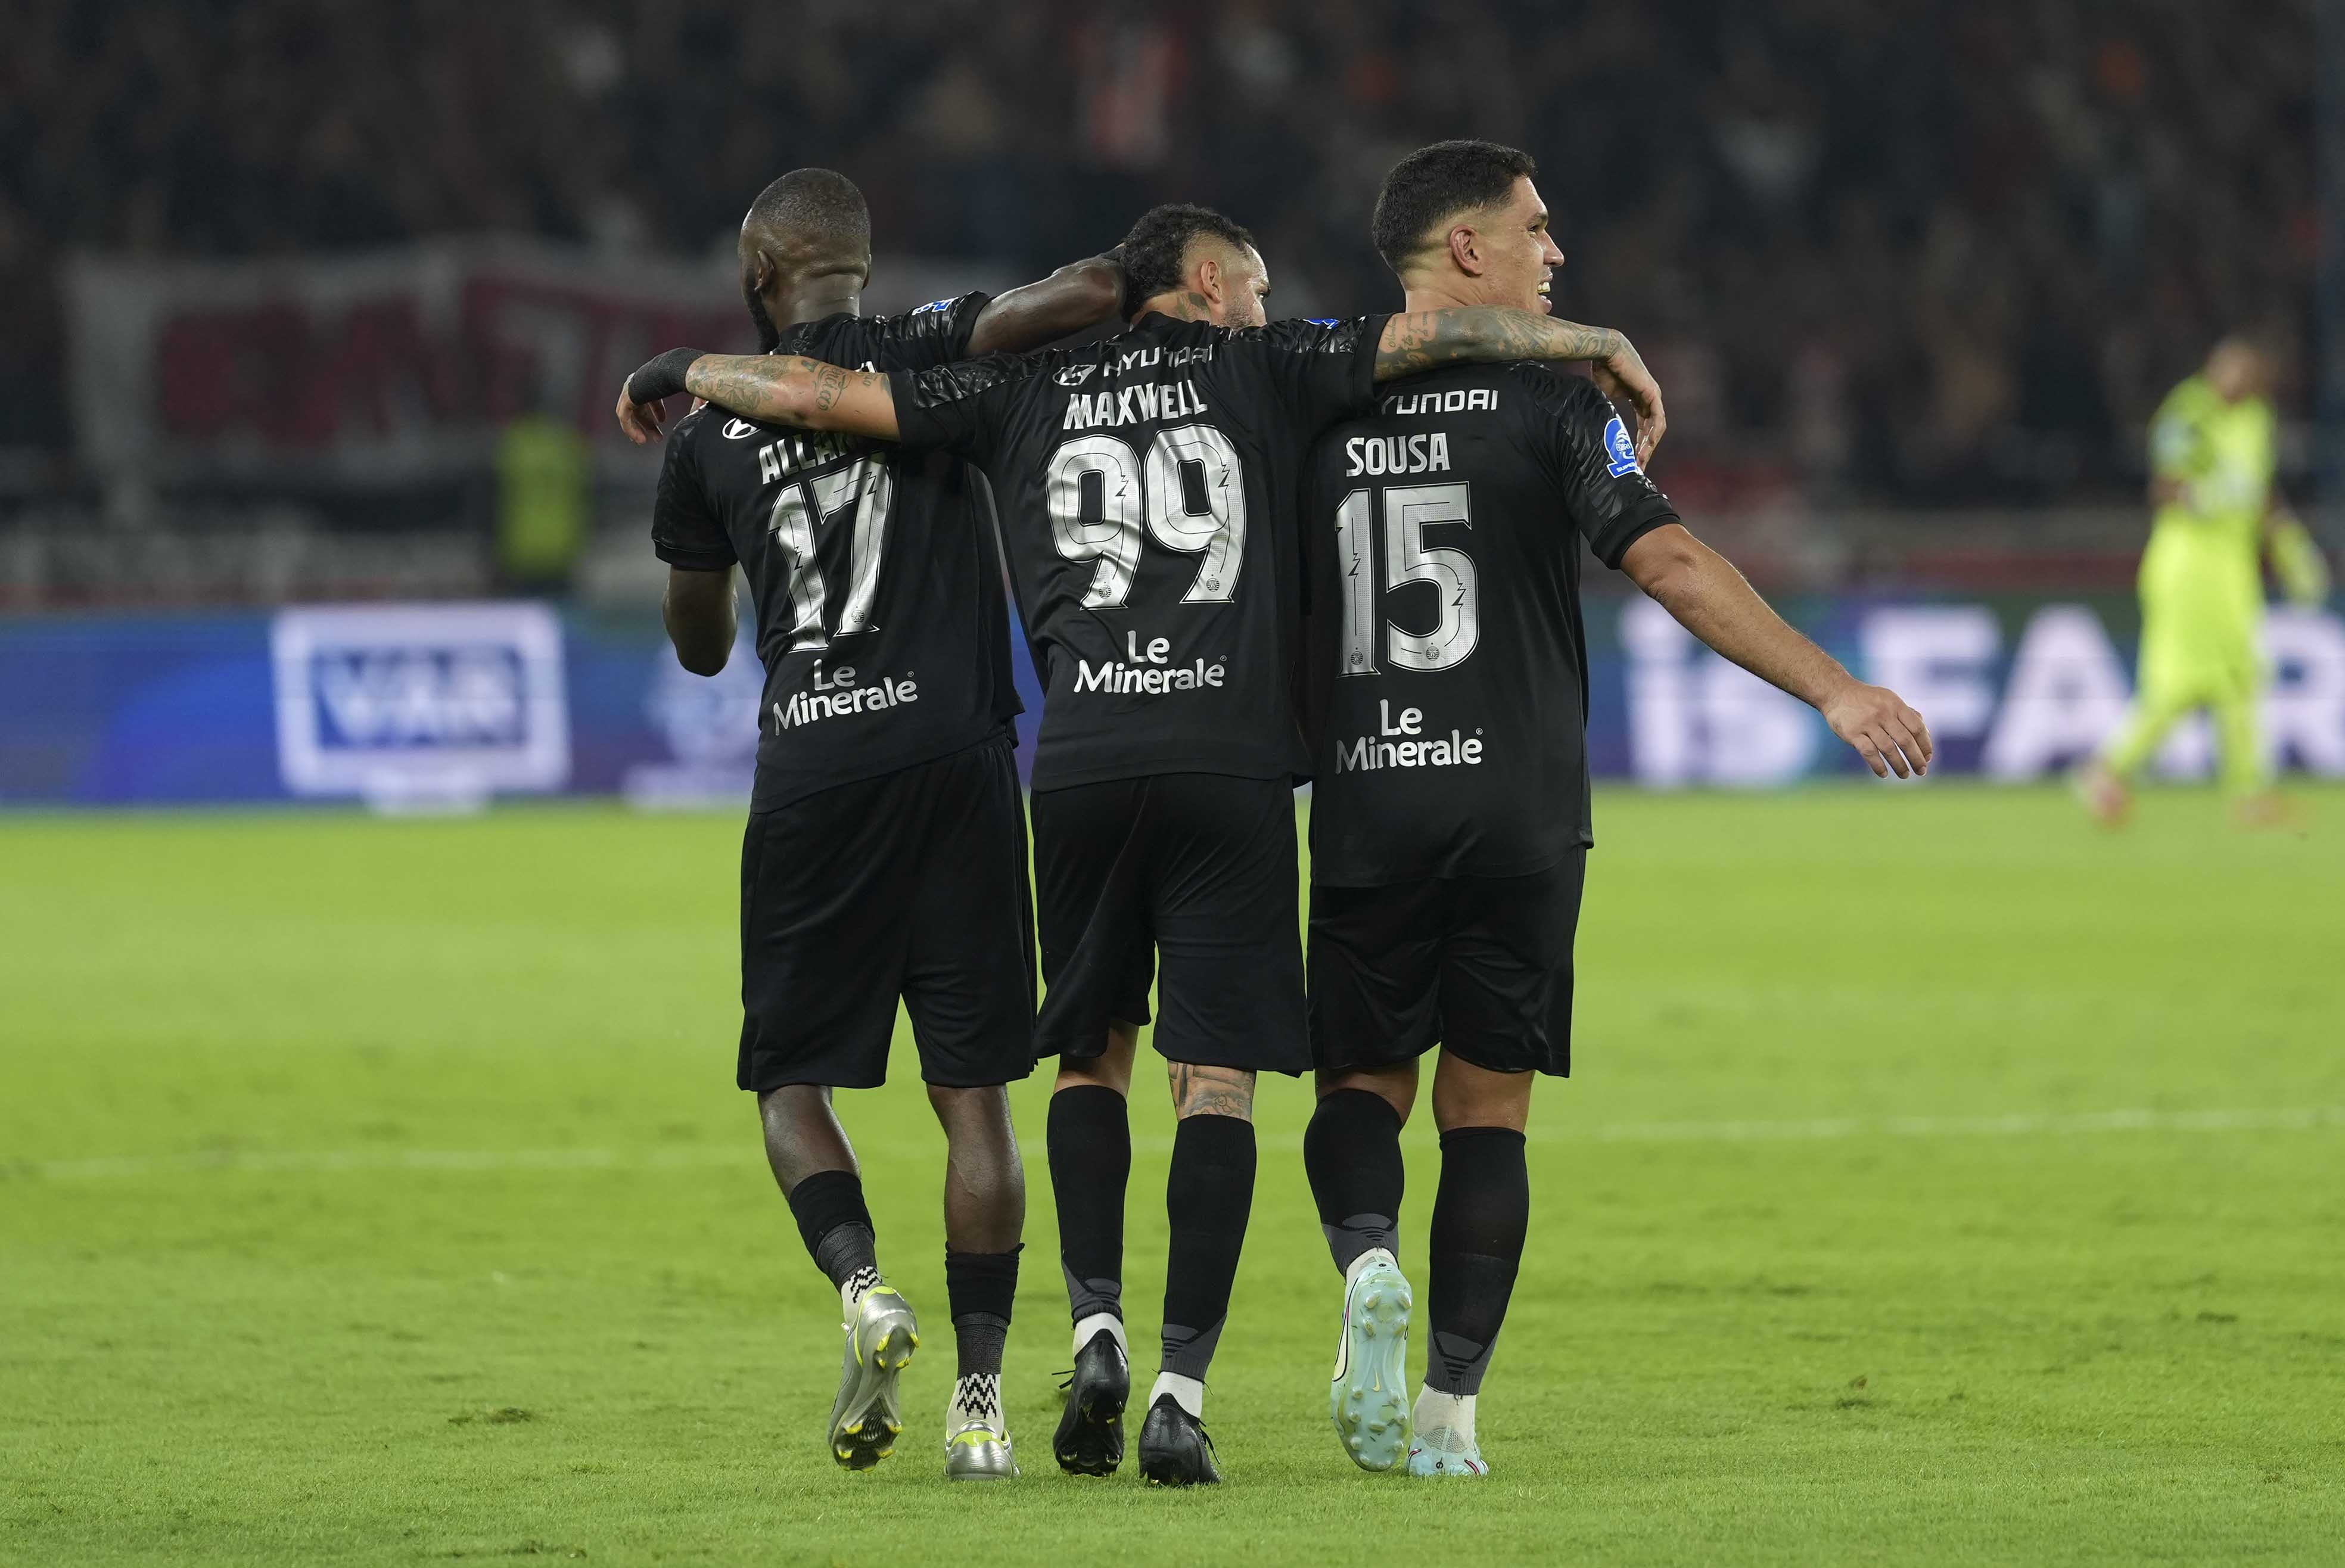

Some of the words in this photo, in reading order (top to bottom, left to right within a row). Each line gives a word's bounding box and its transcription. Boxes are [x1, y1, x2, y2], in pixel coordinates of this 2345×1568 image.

[1062, 379, 1208, 430] MAXWELL
[1381, 389, 1498, 415] YUNDAI
[1346, 433, 1451, 477] SOUSA
[1046, 424, 1247, 611] 99
[767, 451, 892, 653] 17
[1335, 481, 1481, 678] 15
[1127, 630, 1170, 664] Le
[814, 658, 856, 690] Le
[1380, 699, 1423, 736] Le
